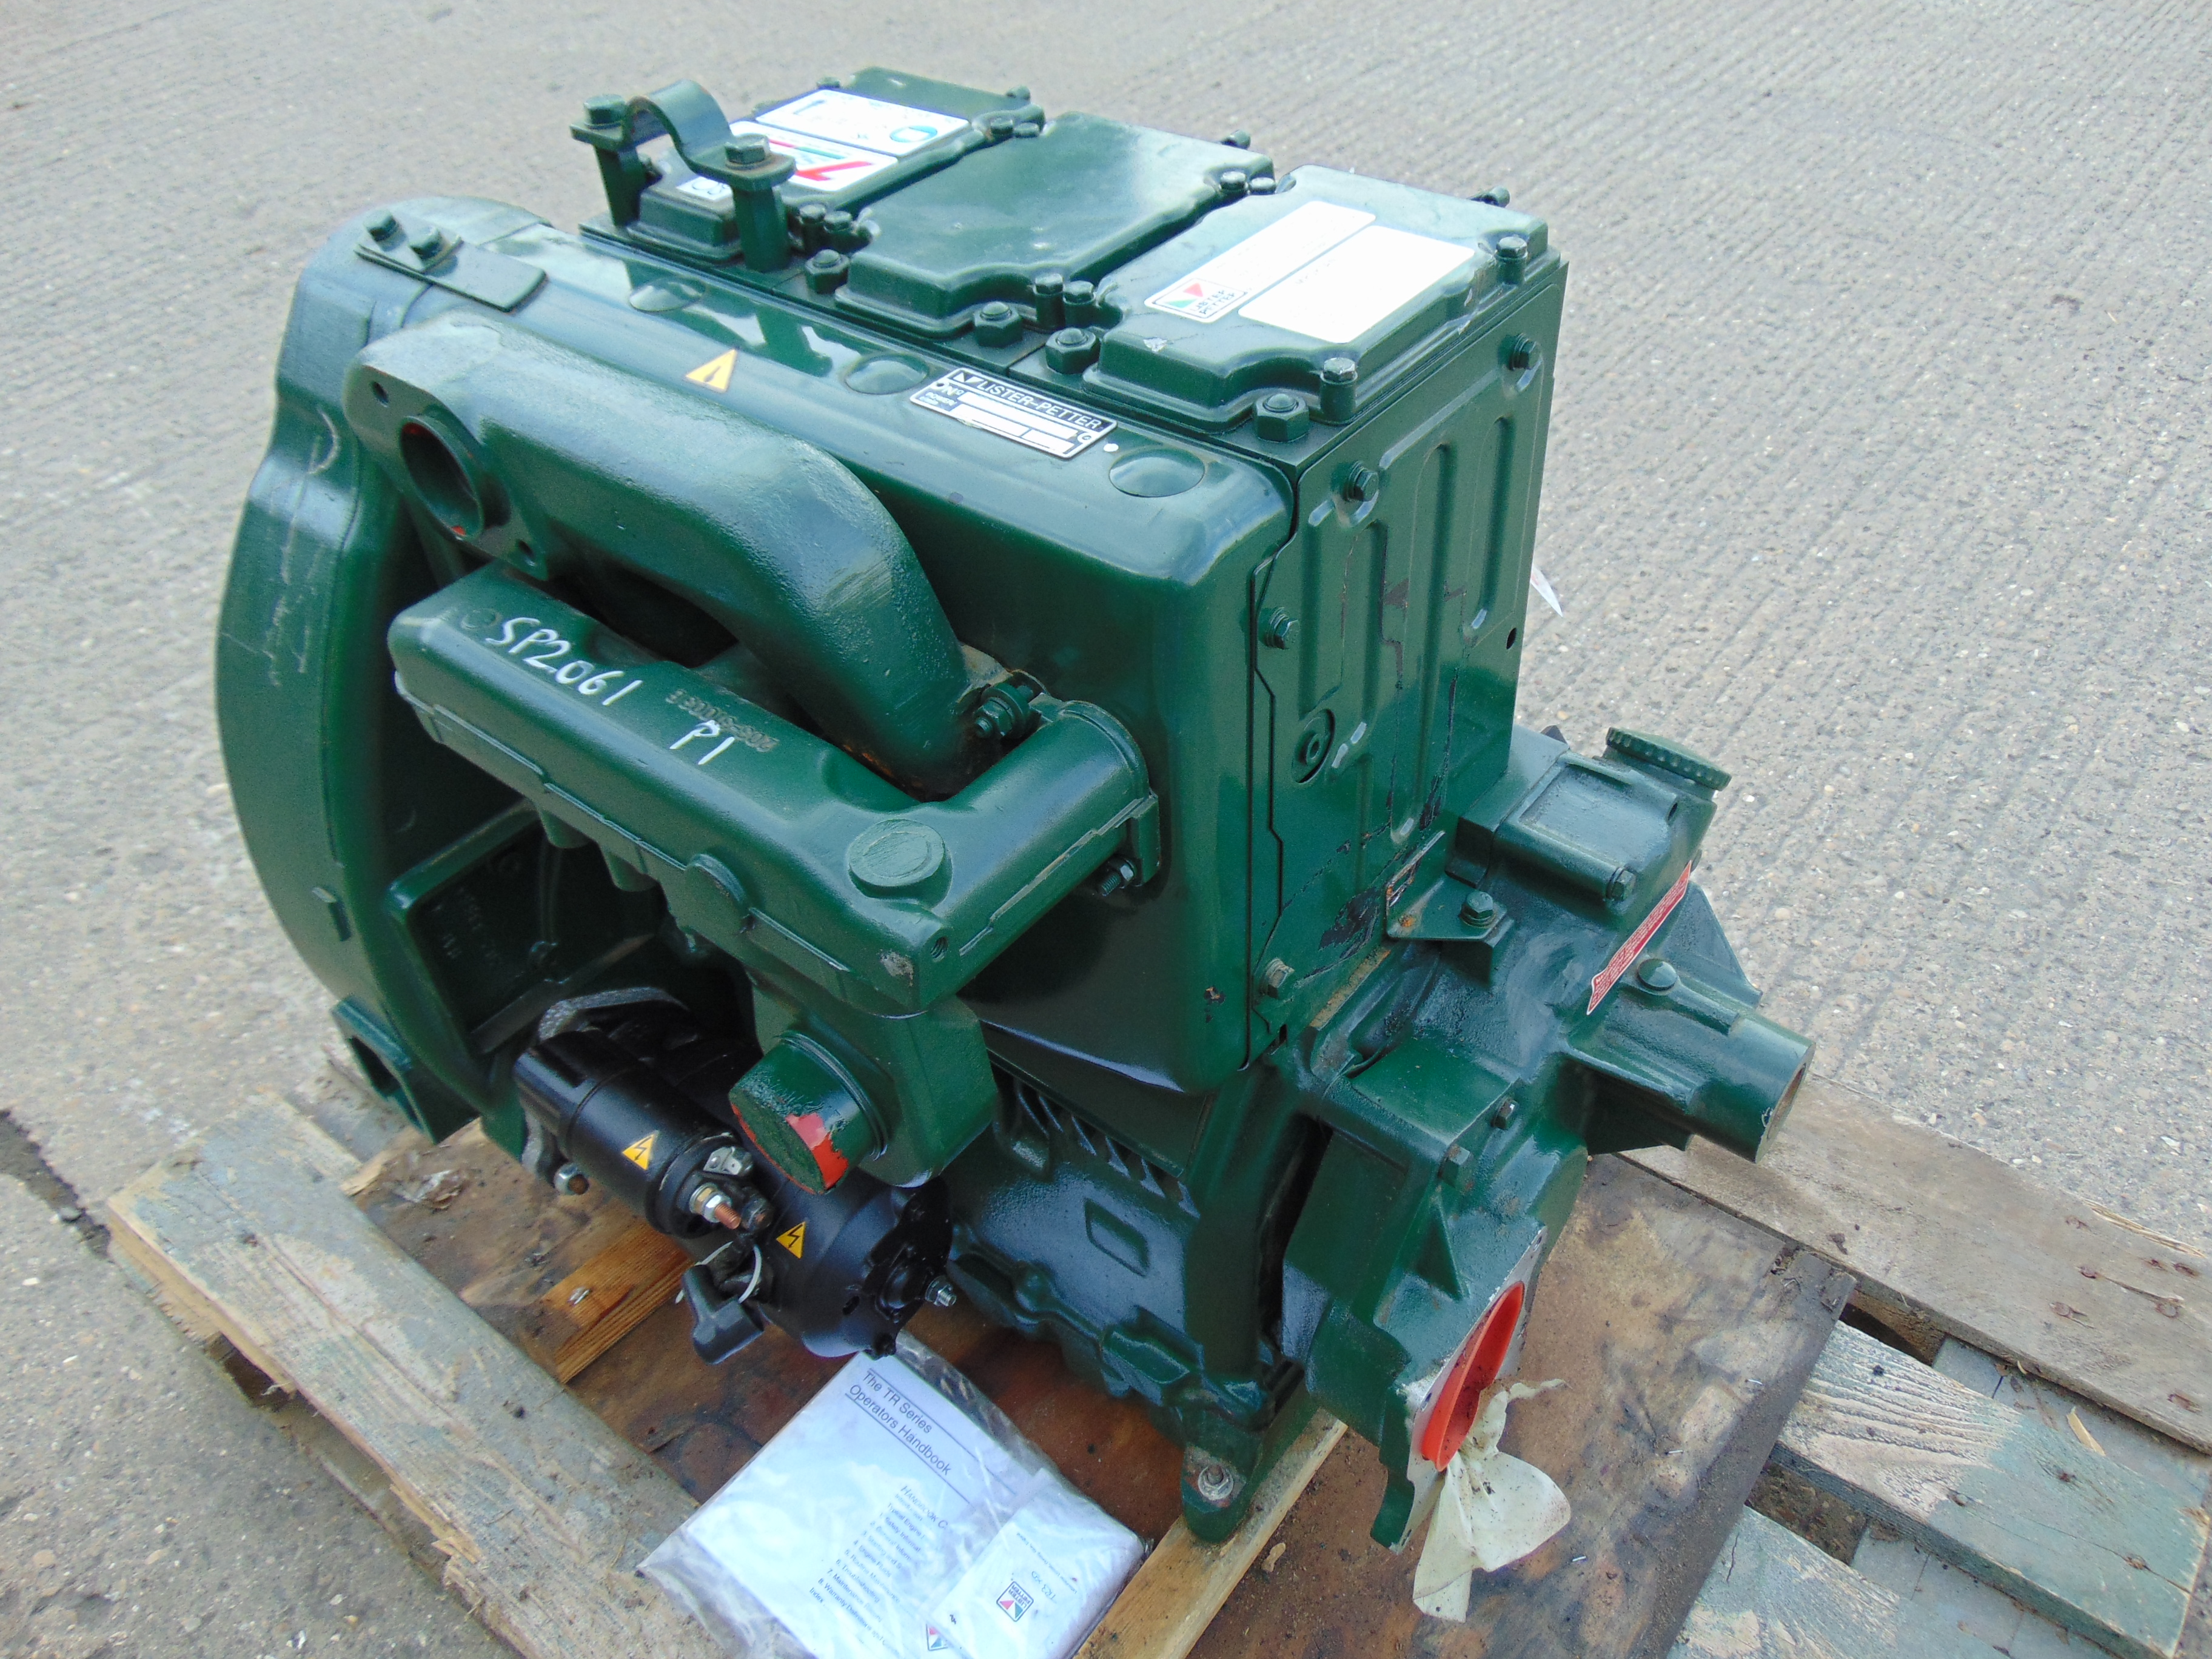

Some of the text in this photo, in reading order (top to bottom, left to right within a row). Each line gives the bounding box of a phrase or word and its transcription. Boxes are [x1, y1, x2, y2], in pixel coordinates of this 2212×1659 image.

[978, 380, 1102, 430] LISTER-PETTER
[485, 617, 643, 706] SP2061
[850, 1384, 952, 1475] Operators Handbook
[862, 1371, 933, 1434] The TR Series
[809, 1587, 825, 1604] Index
[823, 1582, 848, 1608] Warranty
